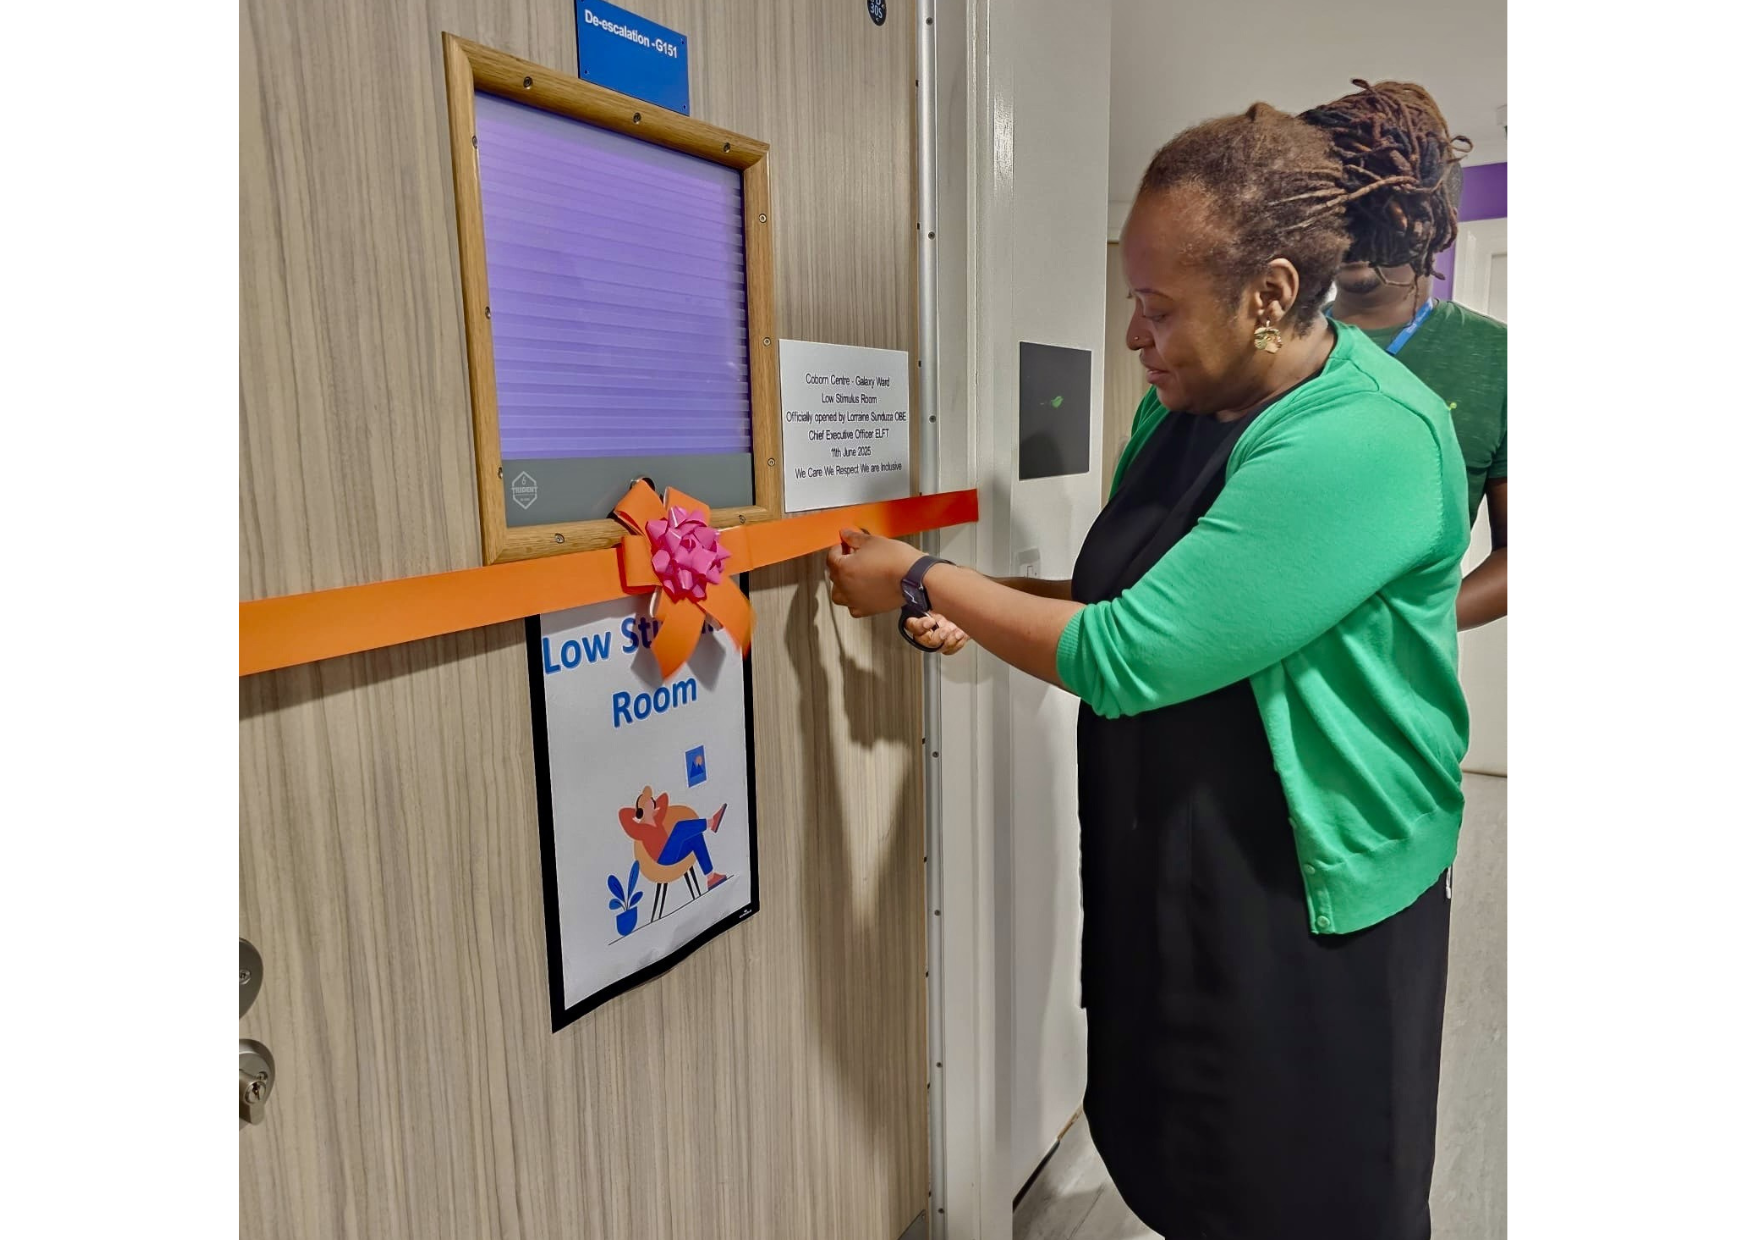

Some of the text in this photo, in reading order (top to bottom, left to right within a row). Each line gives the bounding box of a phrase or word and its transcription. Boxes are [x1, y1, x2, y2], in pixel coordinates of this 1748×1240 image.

[584, 8, 678, 59] De-escalation -G151
[806, 373, 828, 384] Coborn
[831, 375, 850, 385] Centre
[856, 376, 874, 388] Galaxy
[876, 377, 890, 387] Ward
[821, 393, 877, 404] Low Stimulus Room
[786, 411, 813, 424] Officially
[815, 412, 837, 423] opened
[839, 412, 845, 424] by
[847, 412, 869, 422] Lorraine
[895, 411, 906, 421] OBE
[809, 429, 889, 440] Chief Executive Officer ELFT
[843, 447, 856, 457] June
[858, 446, 871, 456] 2025
[795, 461, 902, 479] We Care We Respect We are Inclusive
[542, 631, 612, 675] Low
[612, 677, 698, 728] Room
